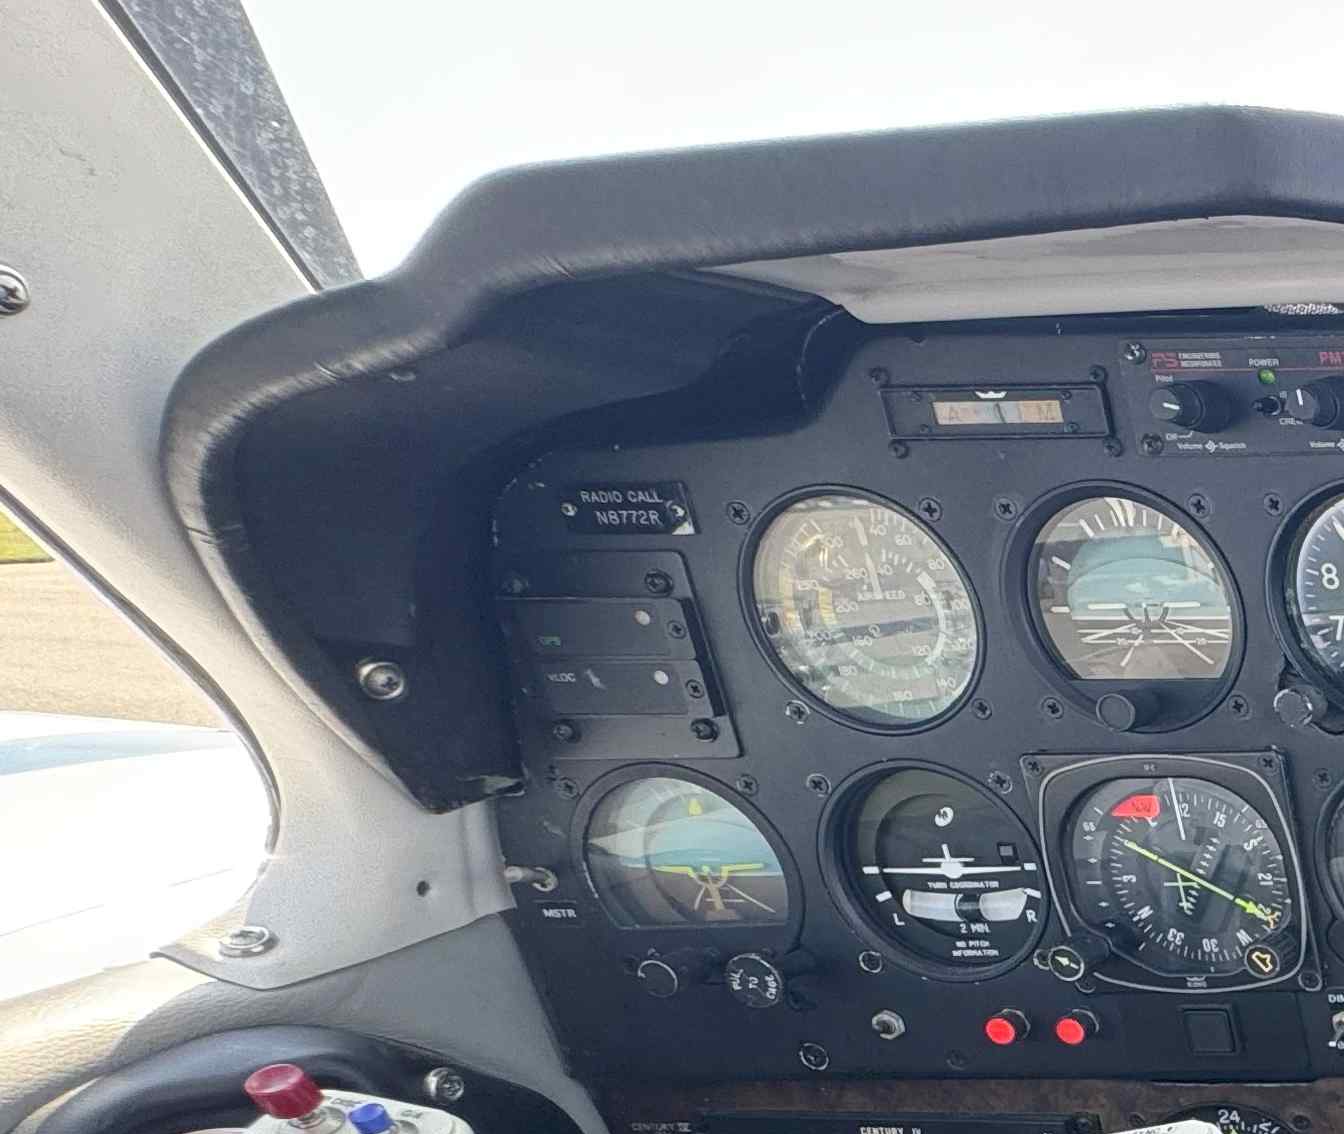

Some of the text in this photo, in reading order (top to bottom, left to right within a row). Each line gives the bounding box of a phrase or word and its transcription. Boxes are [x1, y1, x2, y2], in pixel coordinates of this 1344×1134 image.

[580, 488, 664, 503] RADIO CALL
[595, 510, 663, 527] N8772R
[1321, 563, 1340, 590] 8
[1328, 615, 1344, 641] 7
[1213, 812, 1227, 828] 15
[544, 908, 577, 918] MSTR
[1026, 910, 1037, 923] R
[1167, 928, 1185, 945] 33
[1218, 1109, 1241, 1125] 24
